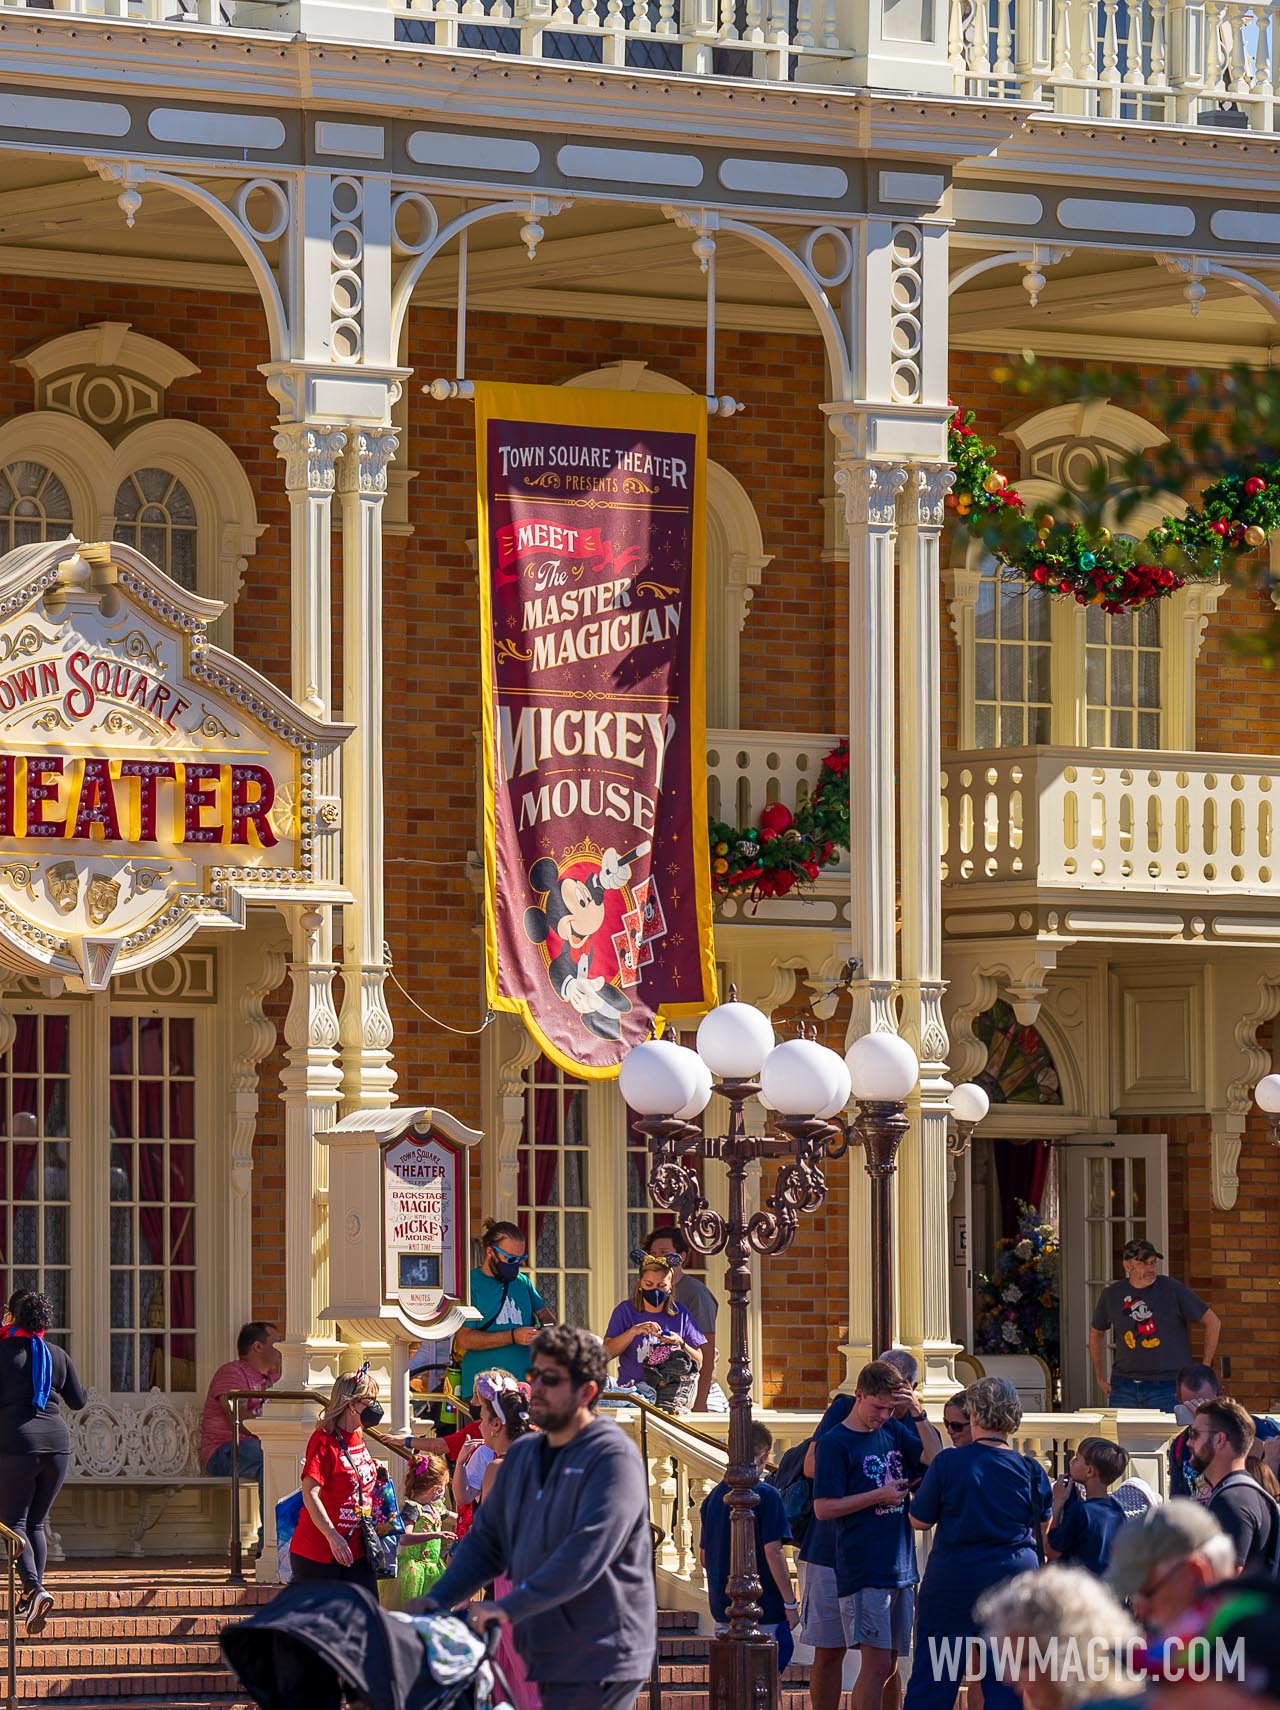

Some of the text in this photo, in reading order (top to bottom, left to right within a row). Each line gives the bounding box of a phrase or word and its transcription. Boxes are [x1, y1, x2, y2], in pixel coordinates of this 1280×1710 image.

[499, 445, 688, 490] TOWN SQUARE THEATER
[565, 476, 619, 493] PRESENTS
[517, 524, 579, 553] MEET
[534, 559, 569, 592] The
[520, 577, 633, 633] MASTER
[531, 601, 682, 673] MAGICIAN
[64, 650, 193, 730] SQUARE
[496, 705, 676, 795] MICKEY
[519, 778, 656, 837] MOUSE
[400, 1148, 441, 1165] TOWN SQUARE
[393, 1165, 446, 1178] THEATER
[392, 1192, 447, 1200] BACKSTAGE
[399, 1200, 441, 1214] MAGIC
[393, 1220, 448, 1242] MICKEY
[405, 1234, 435, 1242] MOUSE
[408, 1243, 420, 1251] WAIT
[410, 1293, 431, 1302] MINUTES
